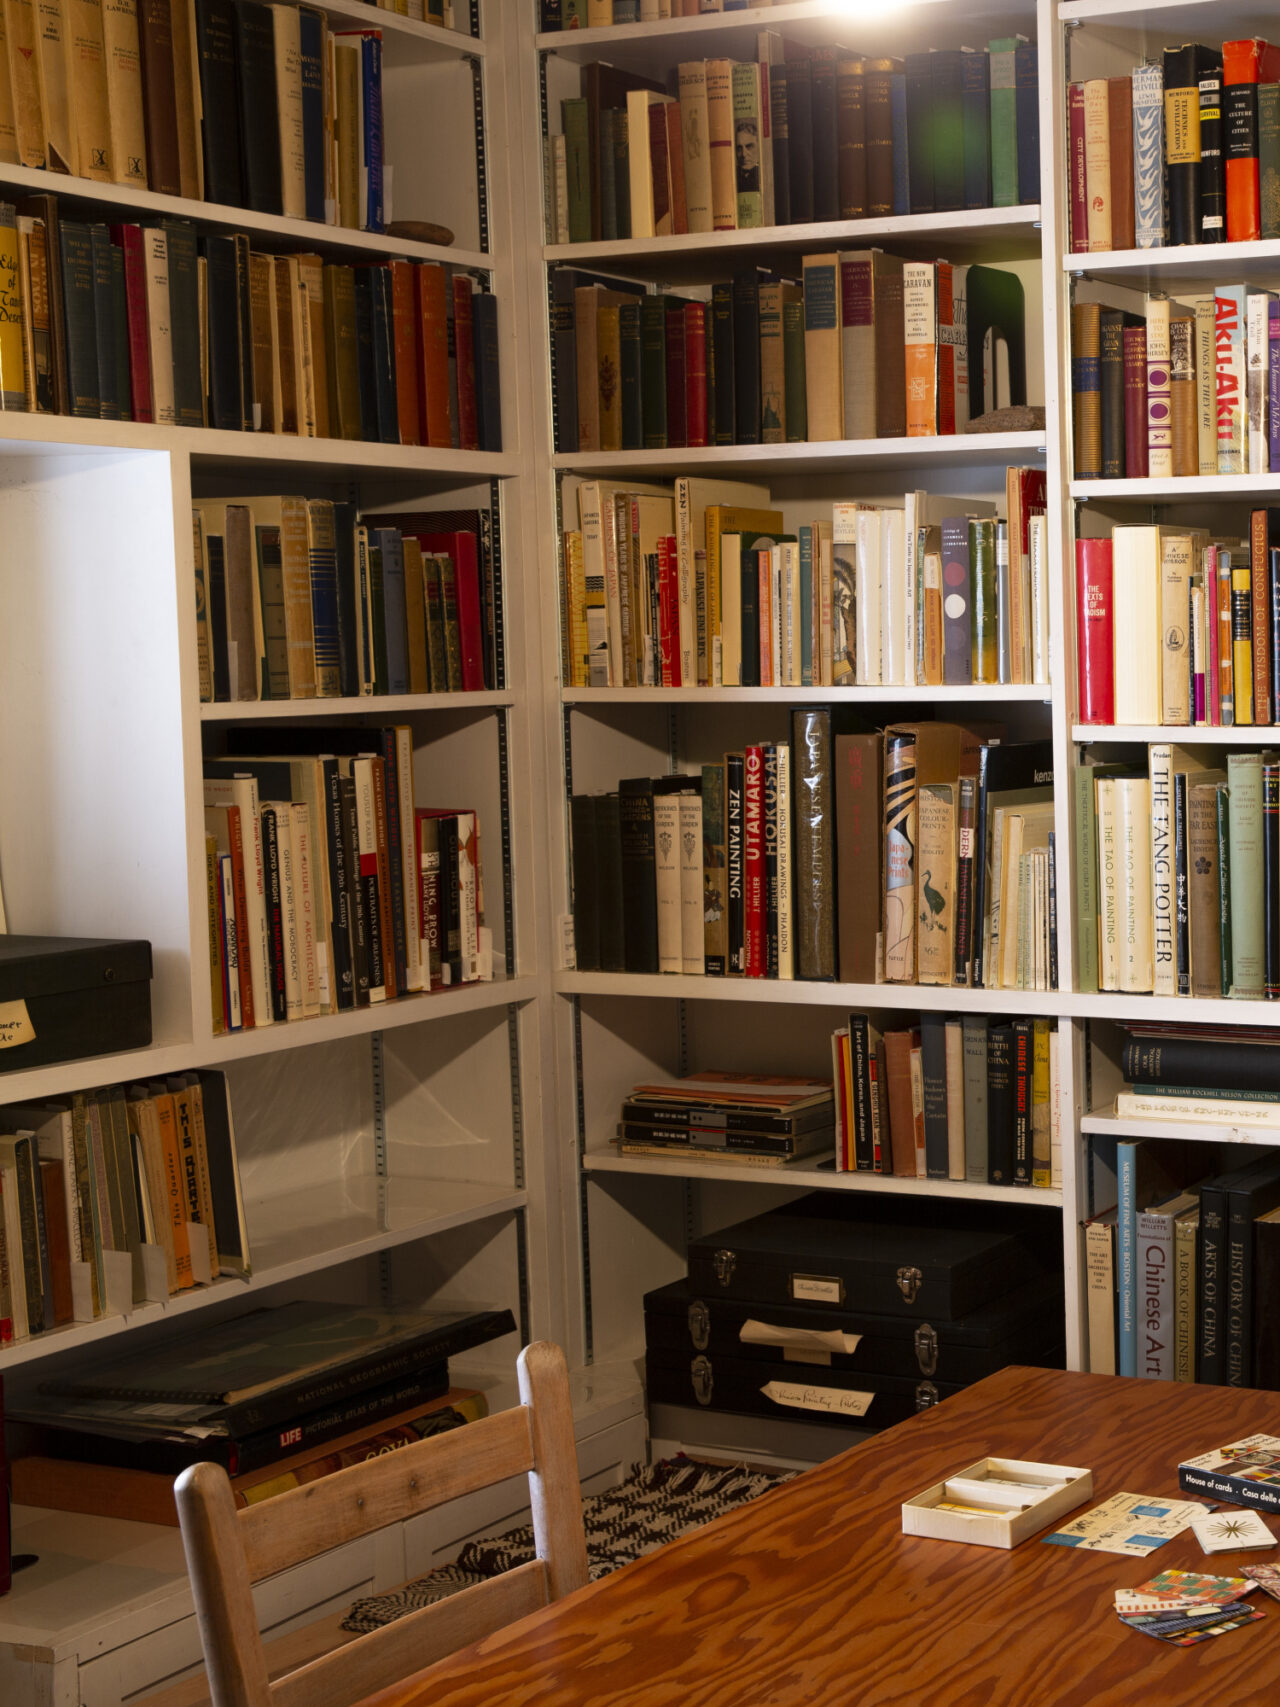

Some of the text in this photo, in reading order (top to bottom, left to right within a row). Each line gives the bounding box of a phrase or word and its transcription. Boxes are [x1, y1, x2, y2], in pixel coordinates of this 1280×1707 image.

[1202, 330, 1210, 366] THINGS
[1203, 369, 1210, 381] AS
[1215, 297, 1238, 440] Aku-Aku
[1203, 415, 1211, 429] ARE
[679, 483, 687, 508] ZEN
[1255, 524, 1266, 712] THE WISDOM OF CONFUCIUS
[330, 774, 339, 799] Texas
[765, 753, 777, 855] HOKUSAI
[1153, 768, 1169, 807] THE
[332, 802, 343, 833] Homes
[747, 755, 760, 860] UTAMARO
[335, 839, 342, 850] of
[336, 853, 344, 865] the
[729, 789, 741, 899] ZEN PAINTING
[256, 865, 264, 895] Wright
[338, 891, 348, 929] Century
[1155, 884, 1172, 963] POTTER
[988, 1057, 1010, 1065] CHINA
[1017, 1036, 1026, 1113] CHINESE THOUGHT
[180, 1104, 192, 1149] THIS
[1146, 1245, 1165, 1376] Chinese Art
[1204, 1240, 1217, 1358] ARTS OF CHINA
[280, 1429, 301, 1447] LIFE
[1185, 1474, 1206, 1486] House
[1207, 1480, 1214, 1489] of
[1214, 1483, 1233, 1493] cards
[1242, 1488, 1259, 1499] Casa
[1260, 1492, 1279, 1504] delle
